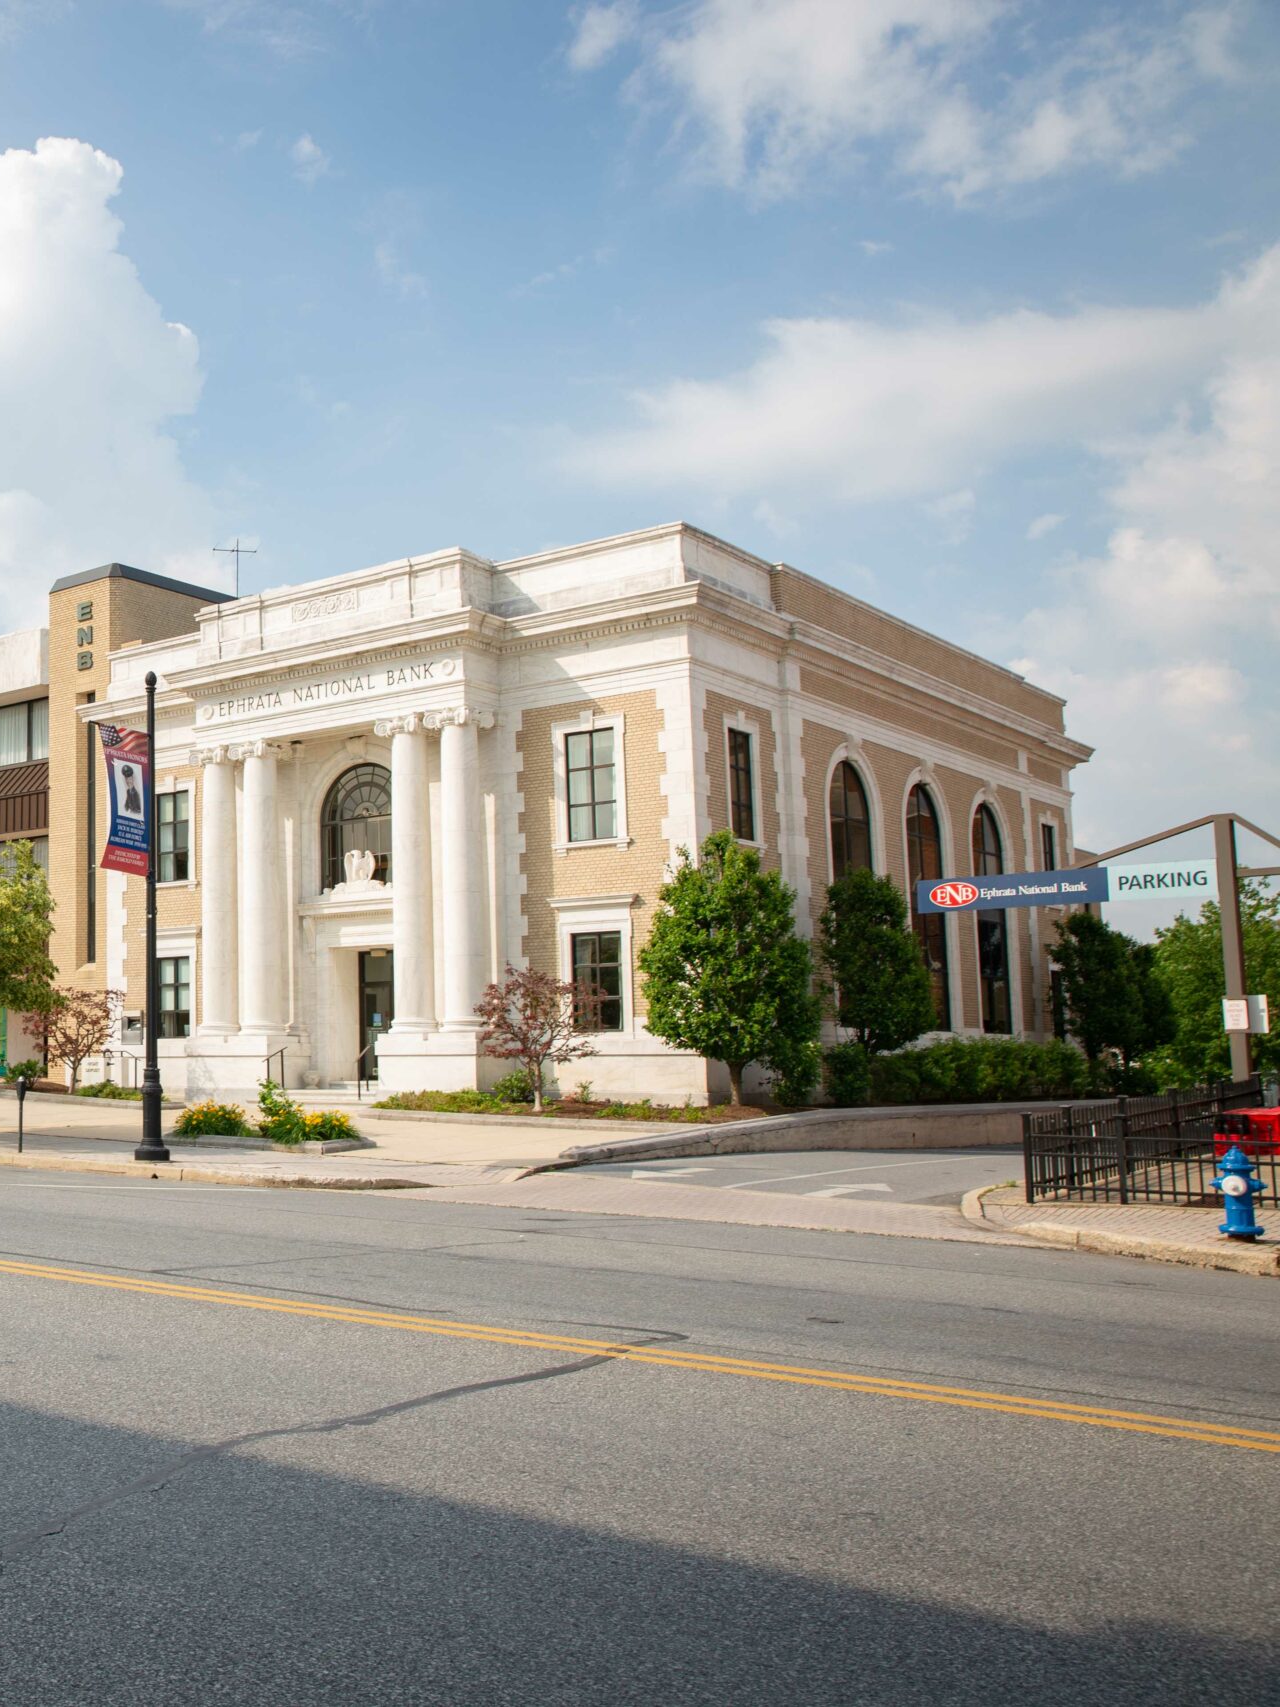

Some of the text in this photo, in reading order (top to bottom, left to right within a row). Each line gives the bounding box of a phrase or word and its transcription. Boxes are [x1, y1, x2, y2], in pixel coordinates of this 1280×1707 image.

[77, 601, 93, 671] ENB
[218, 661, 435, 717] EPHRATA NATIONAL BANK
[936, 881, 1088, 905] ENB Ephrata National Bank
[1118, 870, 1208, 891] PARKING
